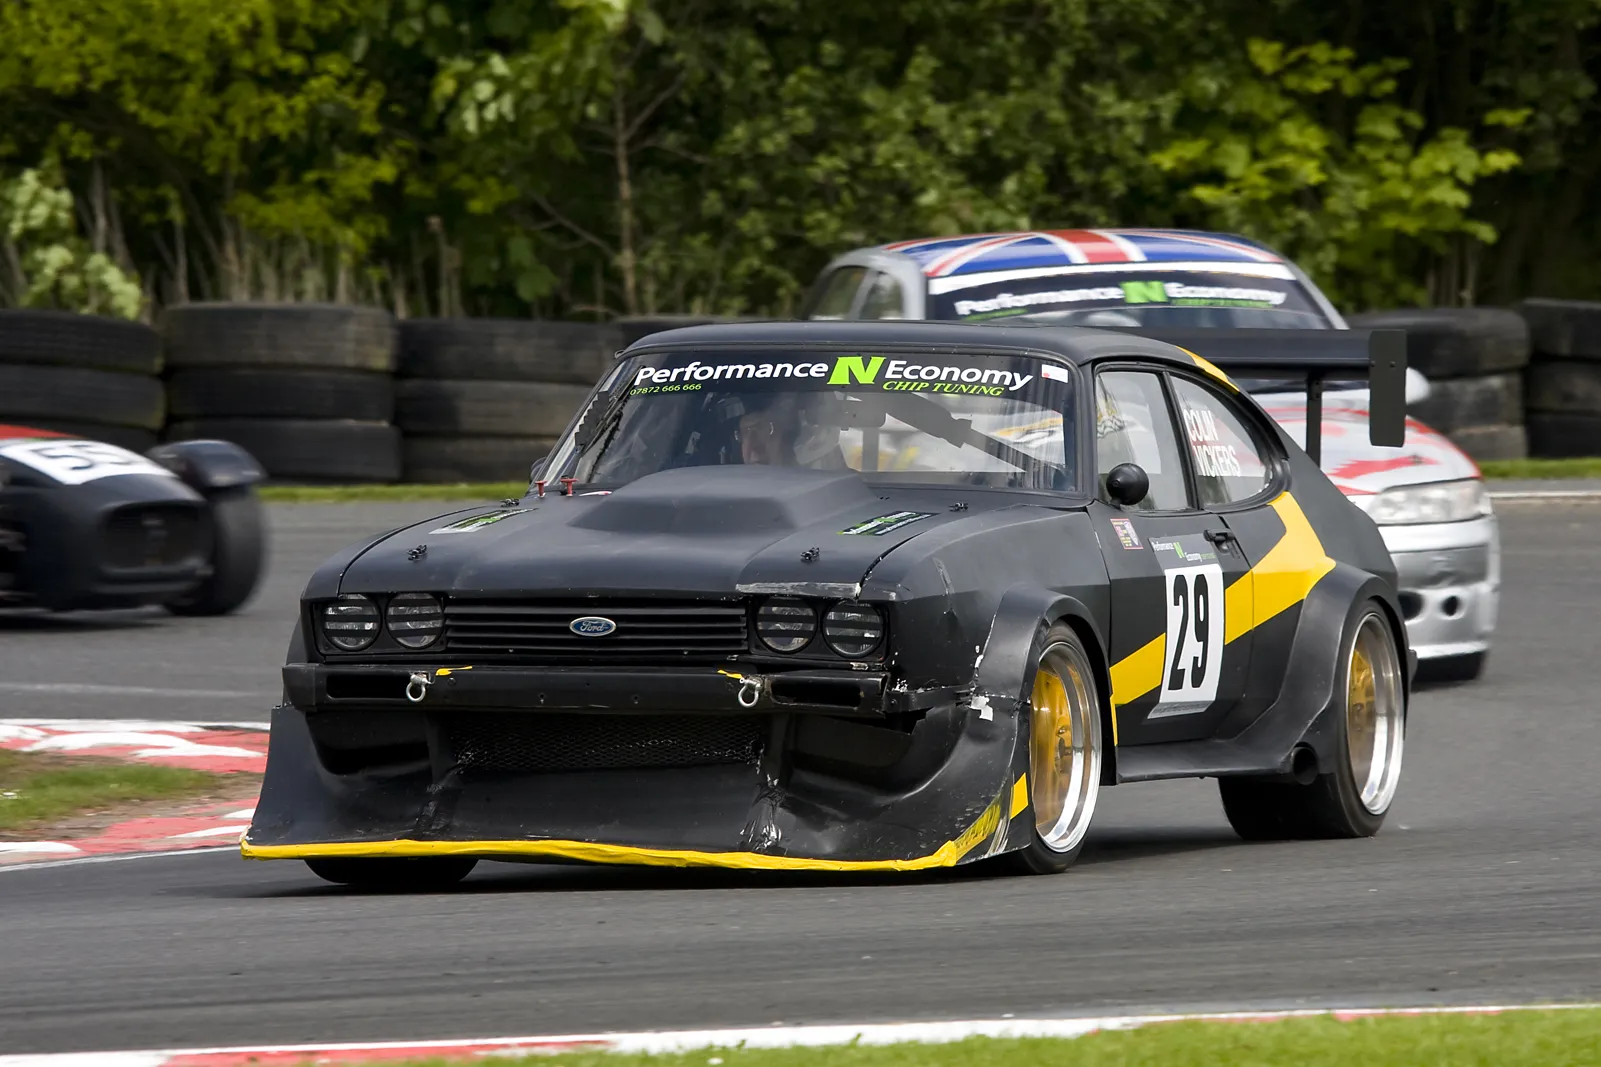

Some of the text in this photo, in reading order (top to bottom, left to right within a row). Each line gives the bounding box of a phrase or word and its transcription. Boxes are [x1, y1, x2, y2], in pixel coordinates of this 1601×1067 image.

[629, 383, 702, 396] 07872 666 666
[634, 356, 1034, 391] Performance N Economy
[882, 381, 1005, 396] CHIP TUNING
[1183, 409, 1219, 441] COLIN
[1193, 445, 1241, 477] VICKERS
[580, 620, 610, 632] Ford
[1168, 573, 1210, 691] 29
